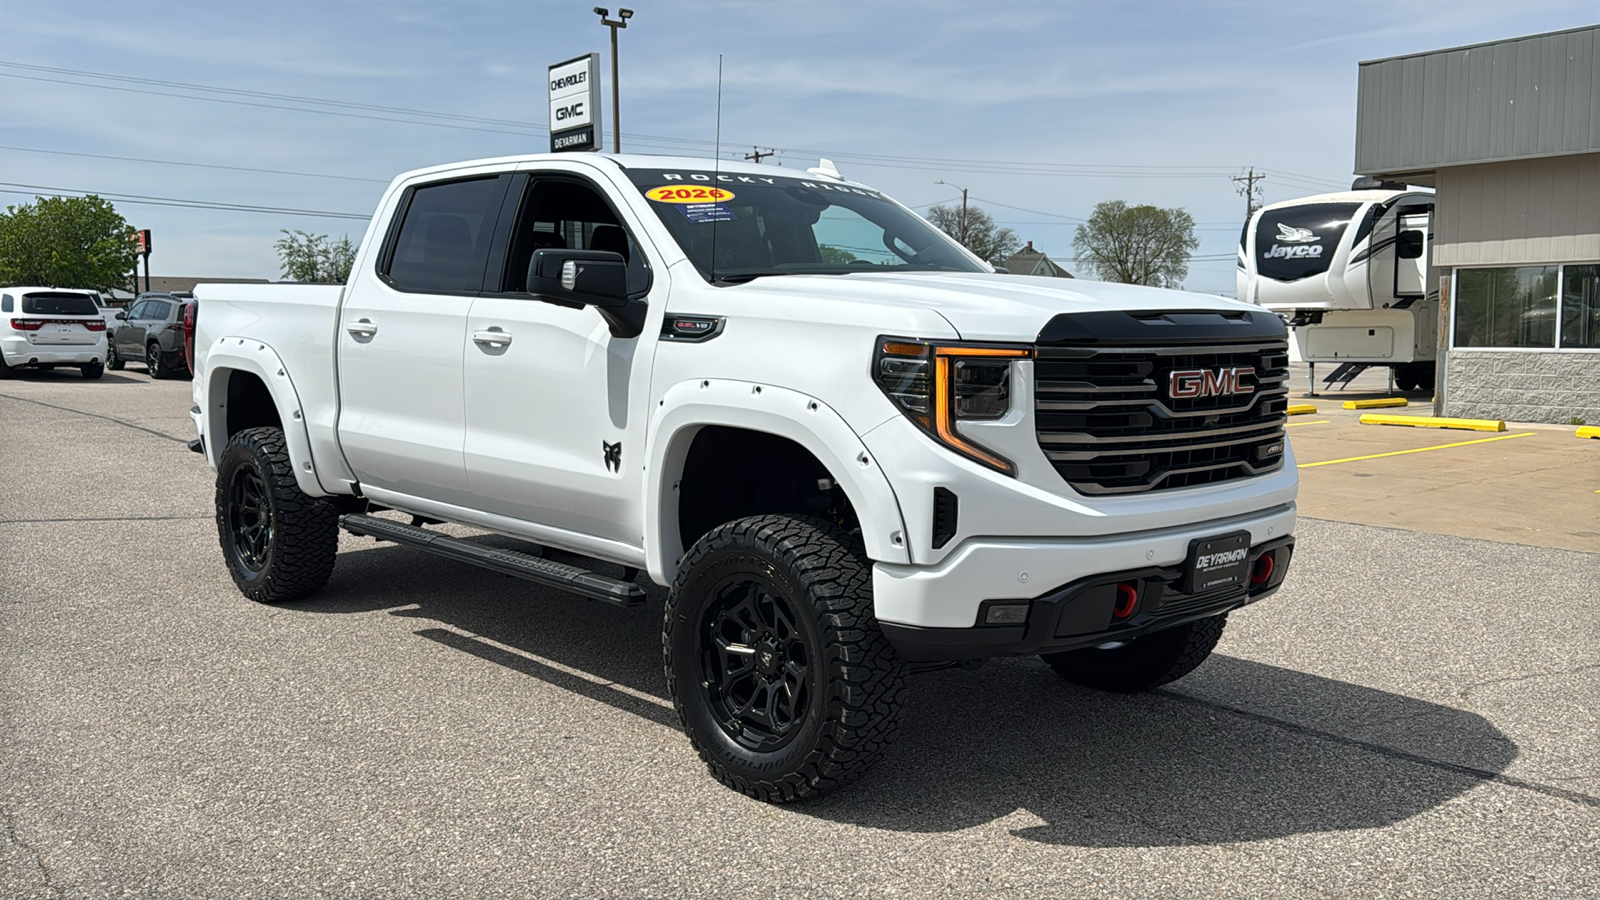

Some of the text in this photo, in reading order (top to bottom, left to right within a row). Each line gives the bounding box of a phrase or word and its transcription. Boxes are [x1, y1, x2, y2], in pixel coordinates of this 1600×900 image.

[551, 71, 587, 91] CHEVROLET
[556, 102, 584, 121] GMC
[554, 133, 587, 148] DEYARMAN
[662, 173, 775, 185] ROCKY
[658, 188, 726, 200] 2026
[1264, 244, 1323, 259] Jayco
[1169, 367, 1255, 399] GMC
[1196, 547, 1248, 569] DEYARMAN
